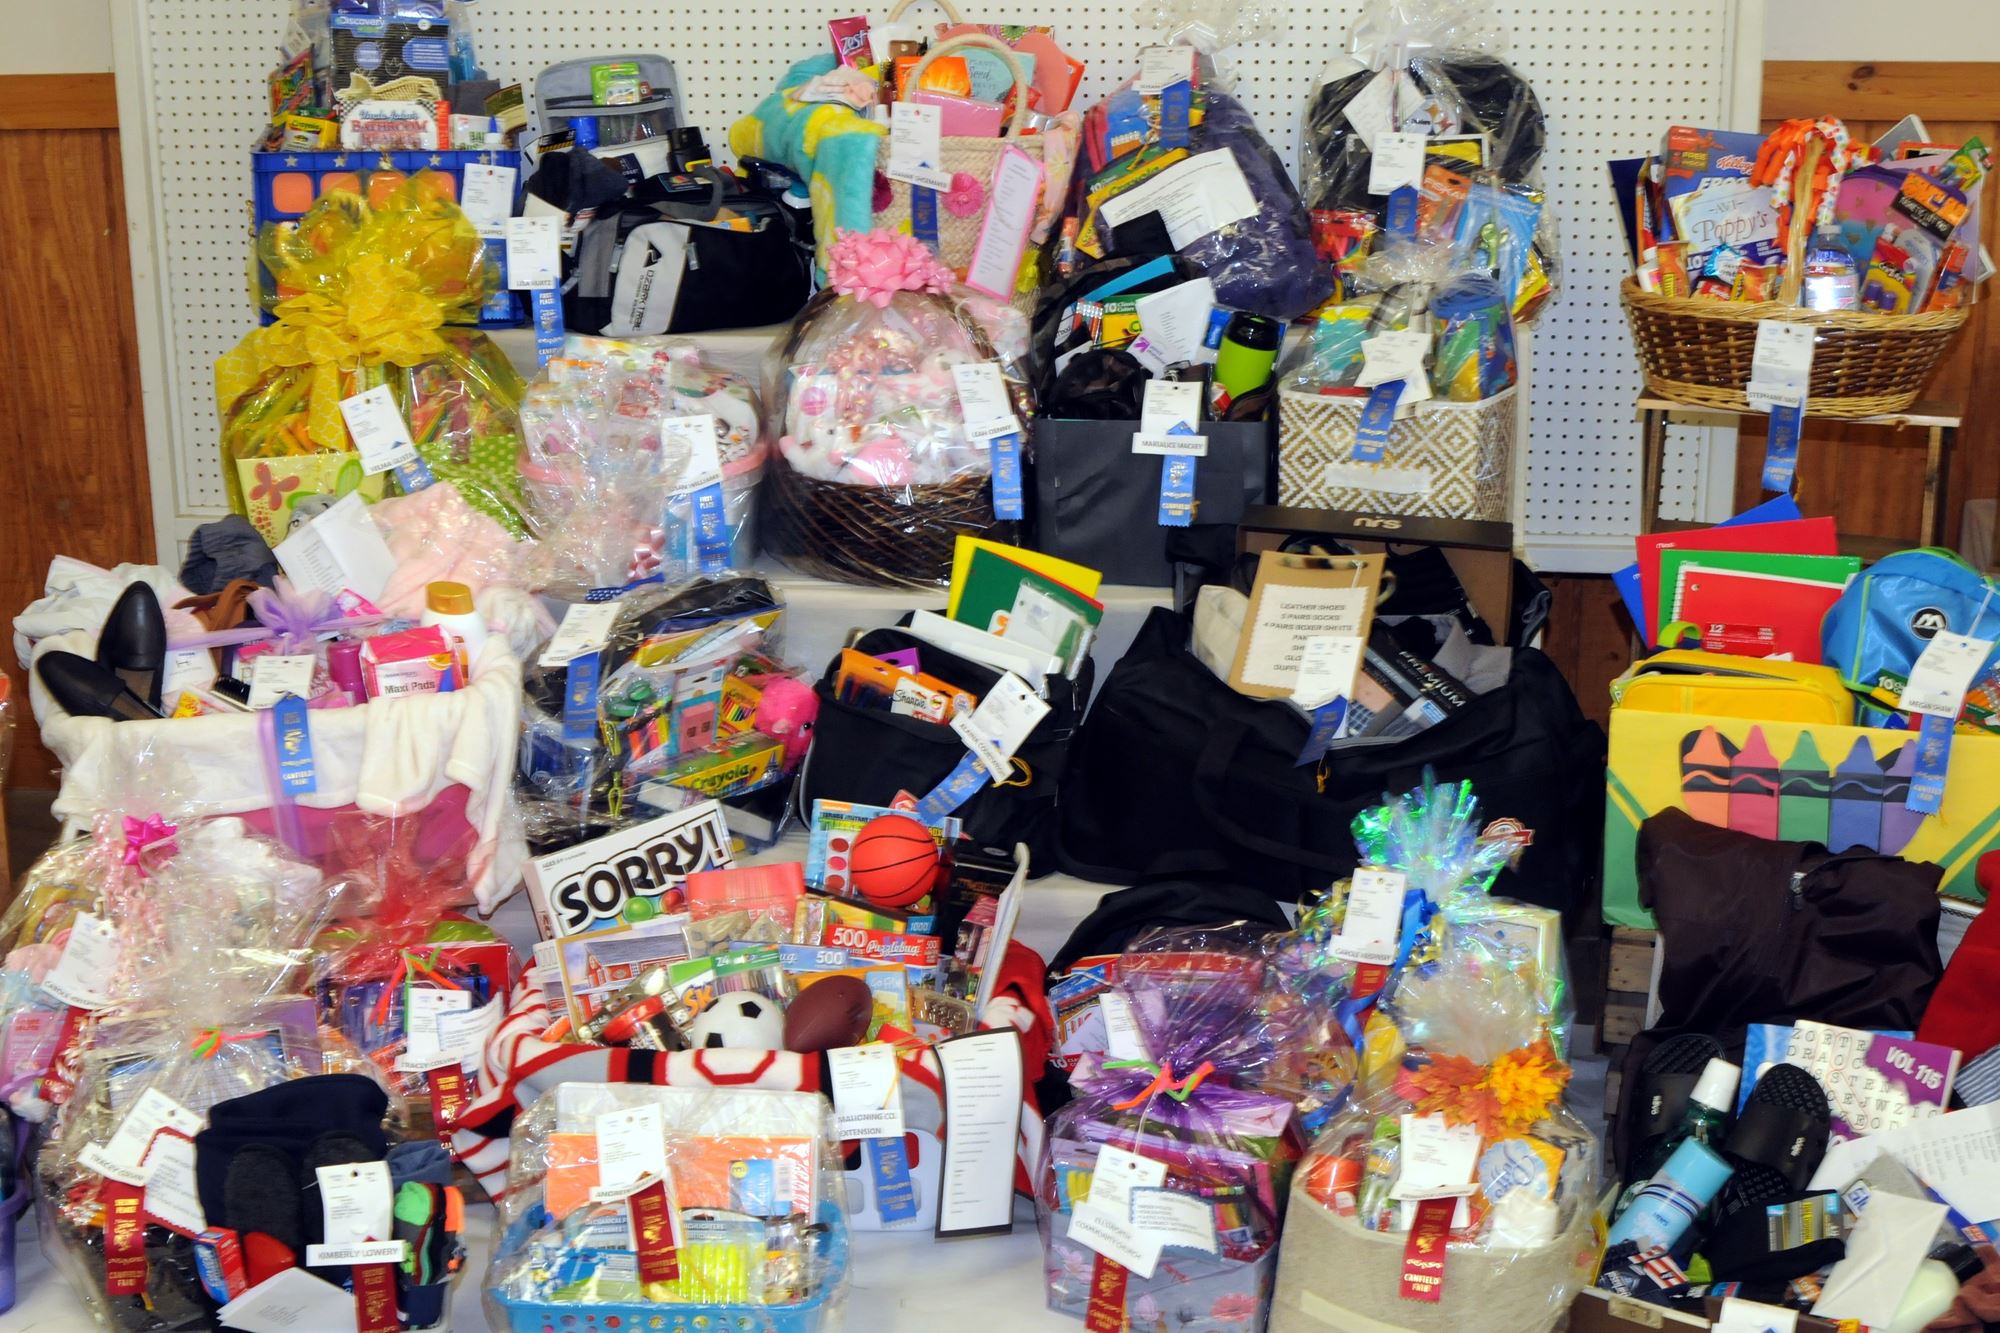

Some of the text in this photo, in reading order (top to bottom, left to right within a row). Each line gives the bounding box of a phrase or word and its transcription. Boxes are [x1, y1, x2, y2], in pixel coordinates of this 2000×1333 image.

[841, 29, 869, 54] Zest
[1691, 210, 1768, 242] Poppy's
[1104, 302, 1117, 313] 10
[1280, 603, 1316, 611] LEATHER
[1270, 622, 1294, 630] PAIRS
[1709, 623, 1726, 635] 12
[384, 678, 436, 695] Maxi Pads
[1878, 676, 1893, 691] 10
[691, 763, 750, 789] Crayola
[559, 819, 725, 929] SORRY!
[832, 927, 869, 947] 500
[866, 940, 921, 960] Puzzlebug
[815, 951, 844, 965] 500
[1885, 1046, 1945, 1090] VOL 115
[838, 1127, 882, 1137] EXTENSION
[318, 1247, 398, 1260] KIMBERLY LOWERY
[1404, 1273, 1440, 1285] CANFIELD
